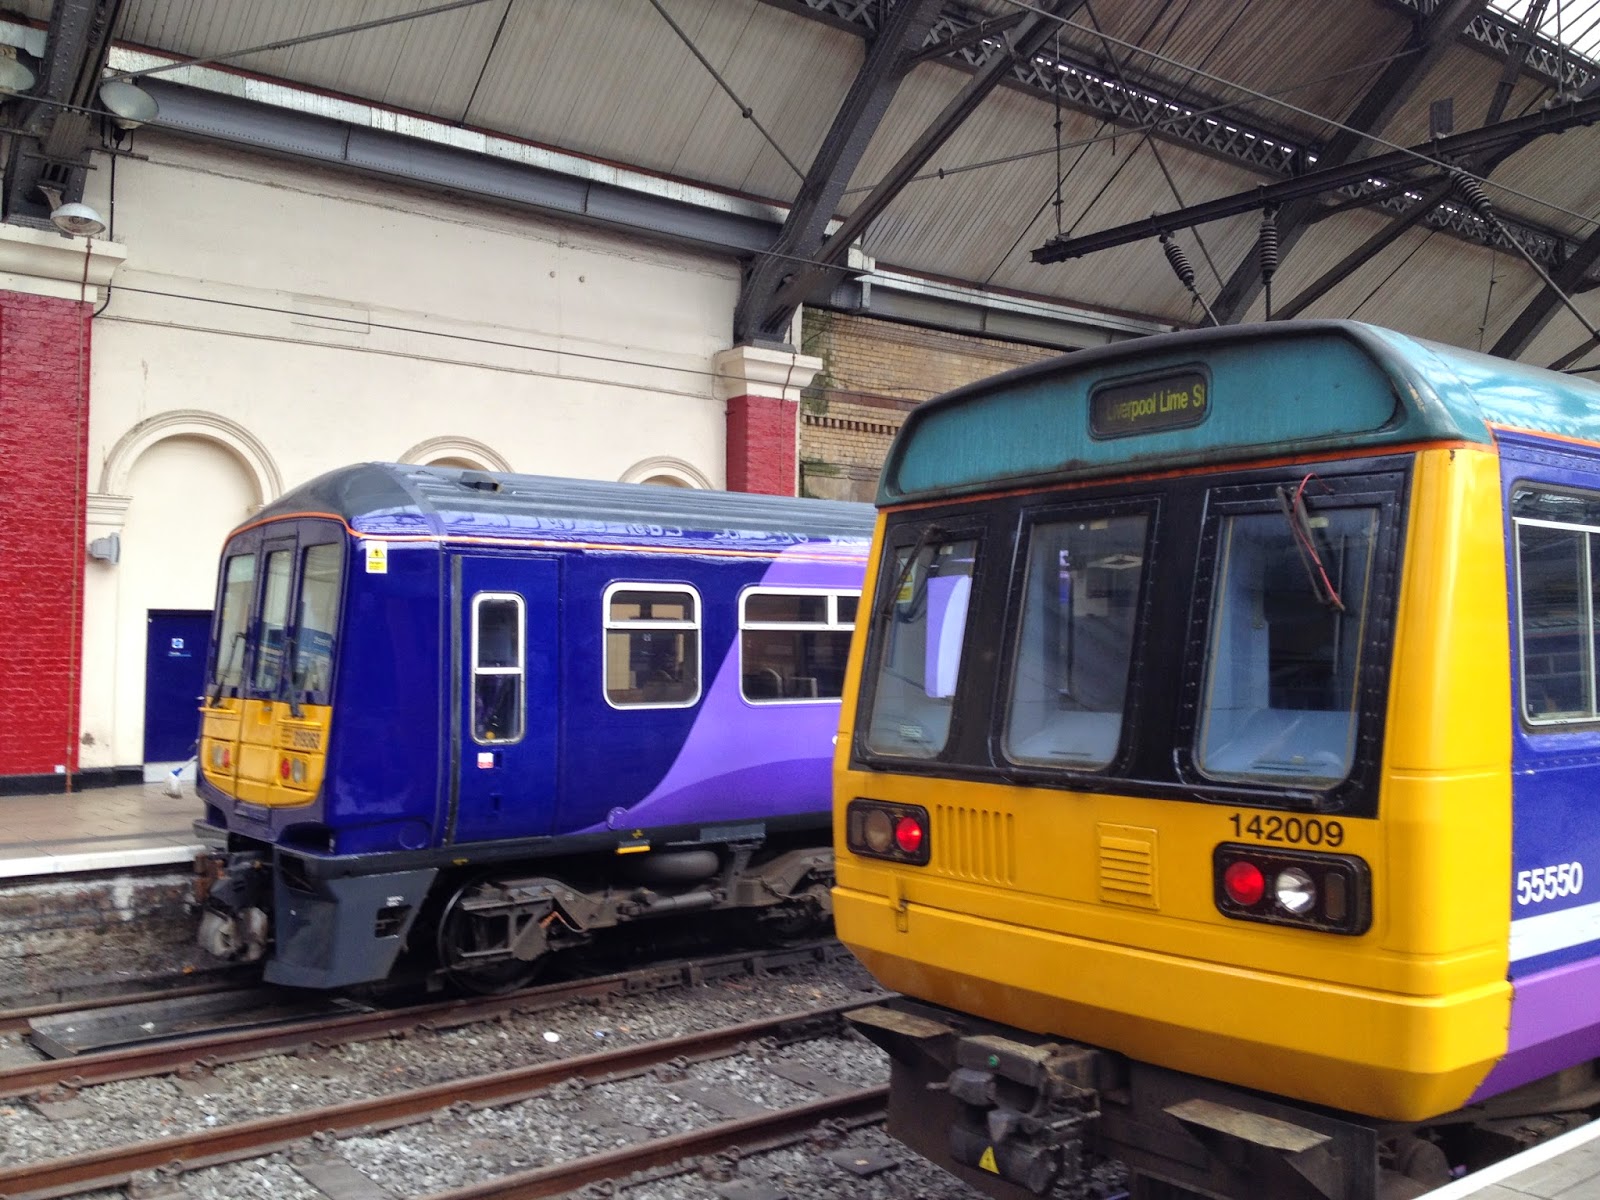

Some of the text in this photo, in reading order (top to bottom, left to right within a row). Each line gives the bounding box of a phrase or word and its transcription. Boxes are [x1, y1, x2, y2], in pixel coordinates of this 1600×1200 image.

[1160, 389, 1189, 412] Lime
[1228, 813, 1344, 847] 142009
[1516, 861, 1583, 905] 55550
